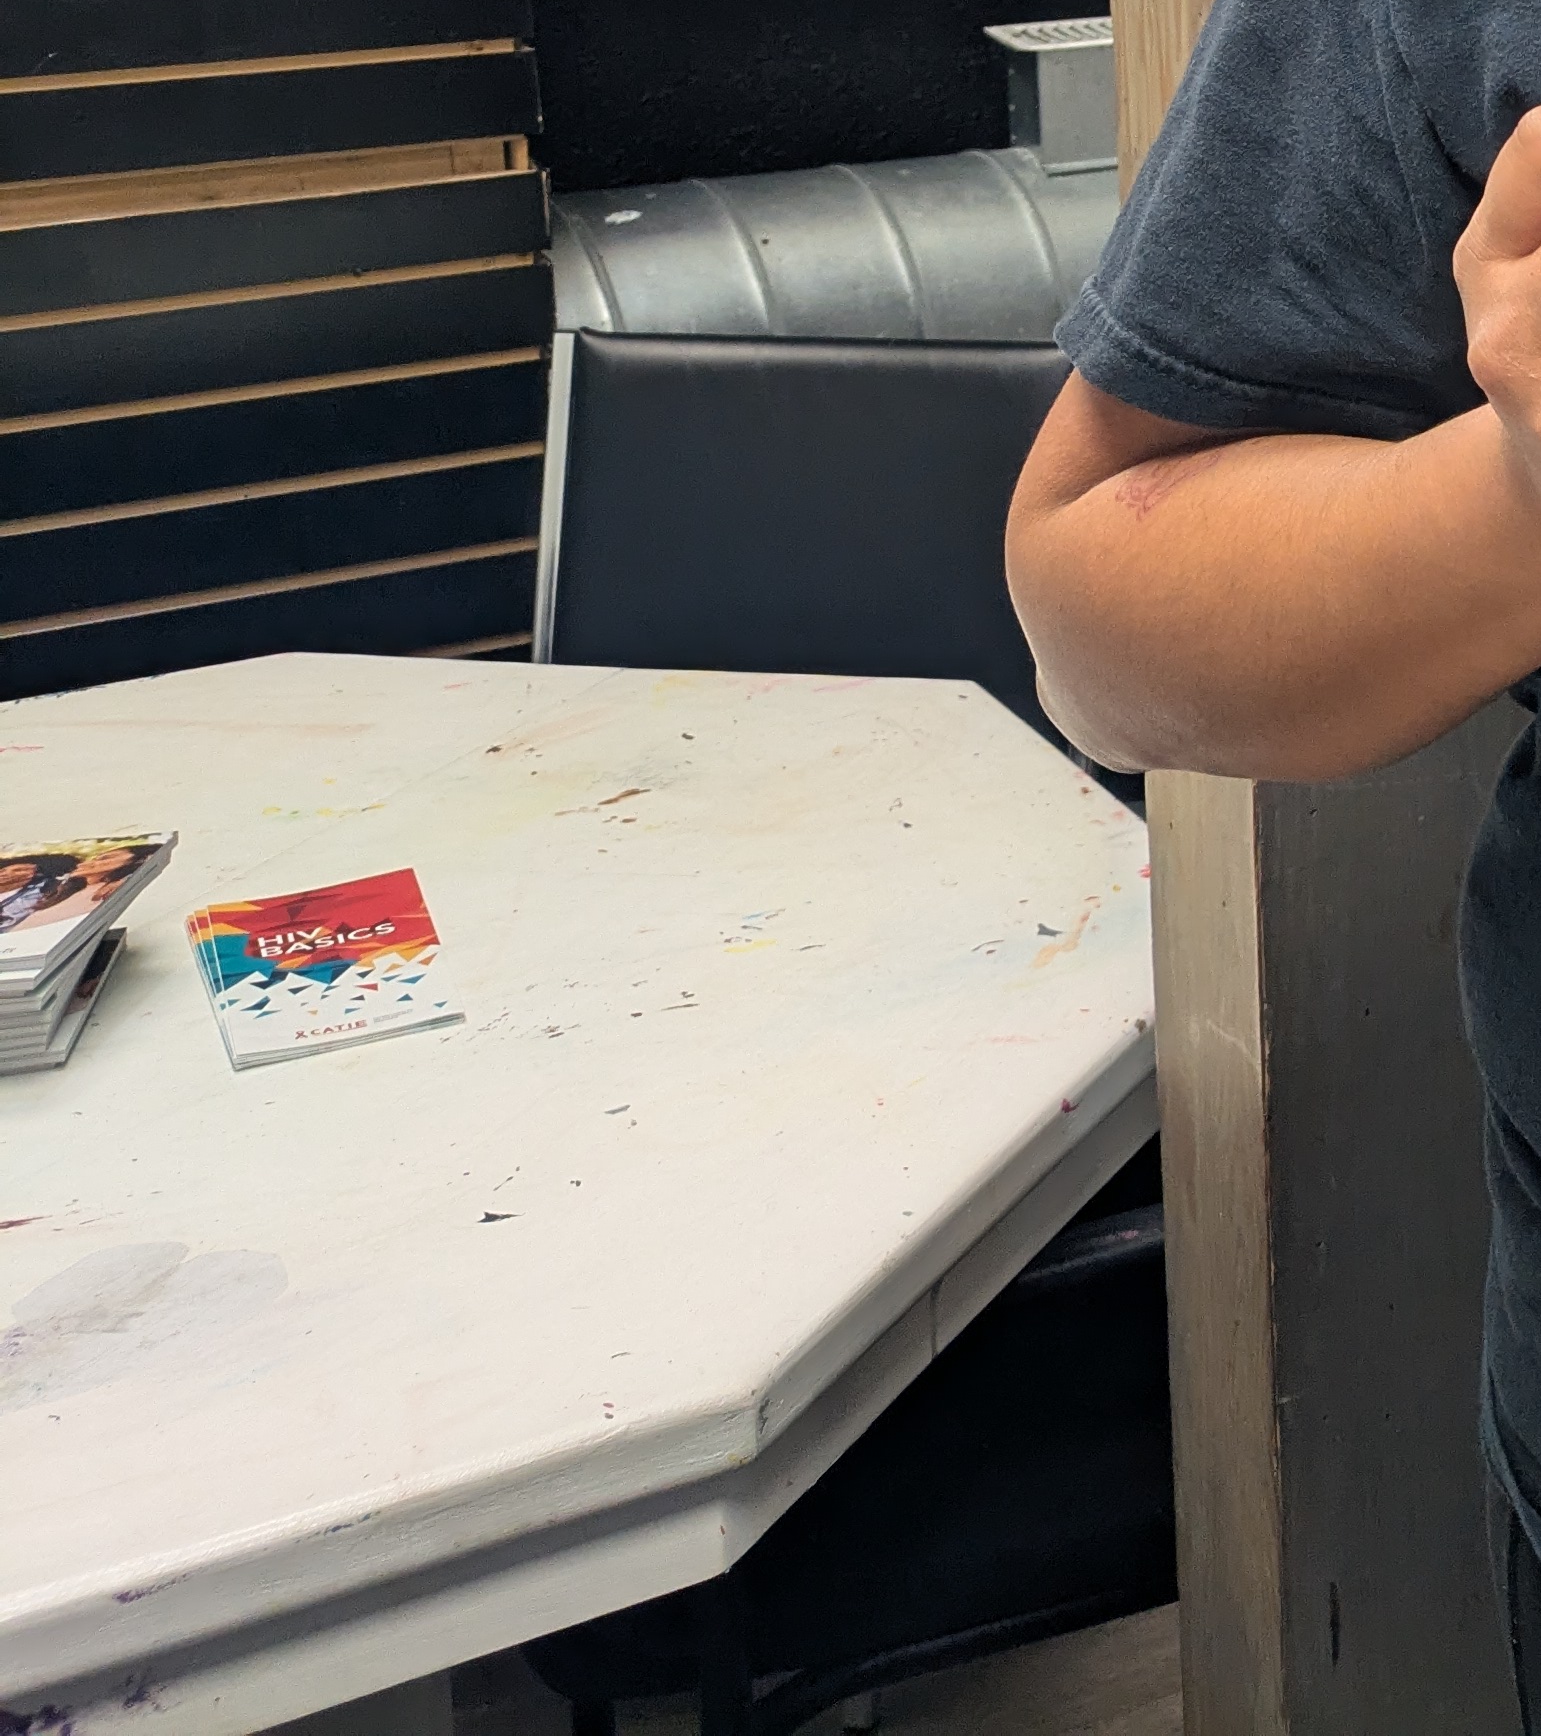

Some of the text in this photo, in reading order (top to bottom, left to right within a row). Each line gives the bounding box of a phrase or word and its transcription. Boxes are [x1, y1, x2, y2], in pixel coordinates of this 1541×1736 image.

[257, 926, 323, 947] HIV
[260, 921, 397, 959] BASICS
[310, 1019, 368, 1036] CATIE
